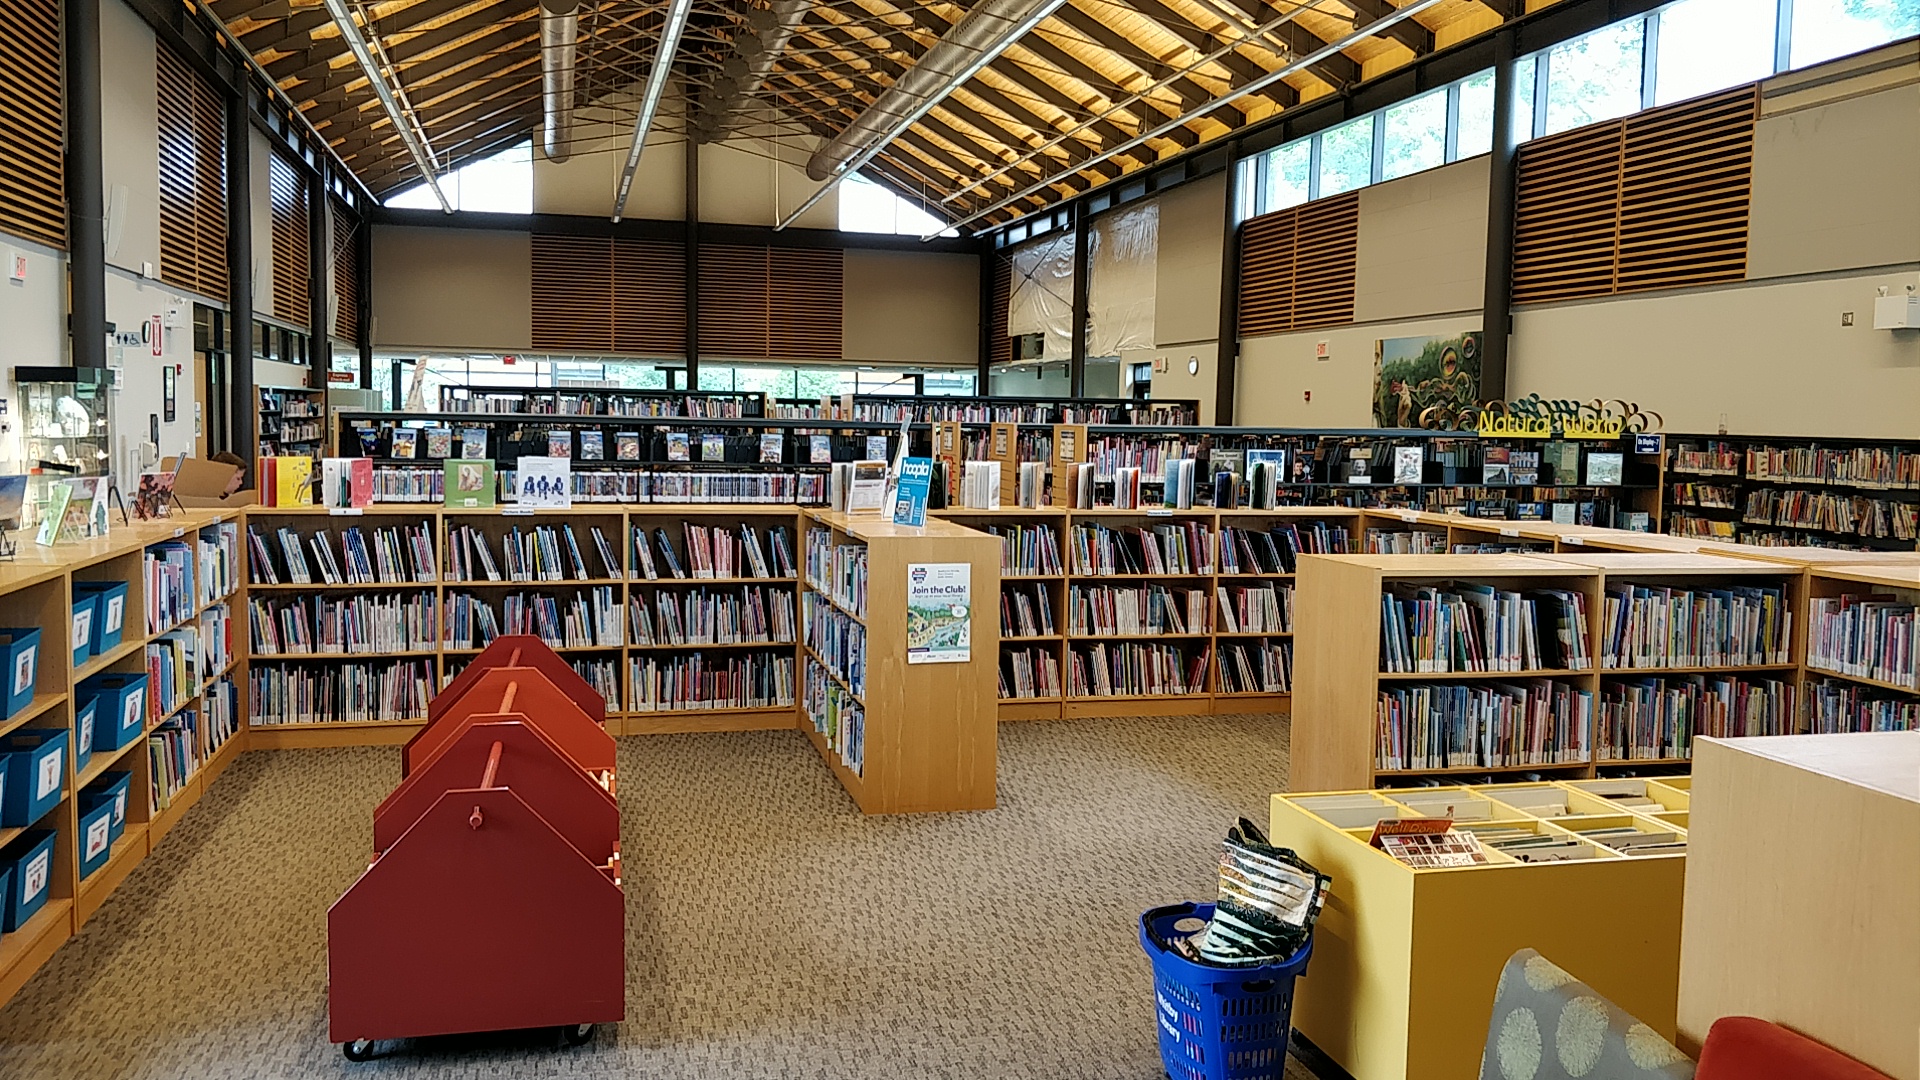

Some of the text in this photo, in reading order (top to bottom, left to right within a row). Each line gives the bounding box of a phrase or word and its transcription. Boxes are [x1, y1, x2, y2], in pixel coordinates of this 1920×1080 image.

[1479, 410, 1622, 436] Natural World
[902, 459, 930, 479] hoopla
[912, 585, 966, 594] Join the Club!
[1157, 989, 1178, 1022] Whitby
[1159, 1009, 1180, 1043] Library
